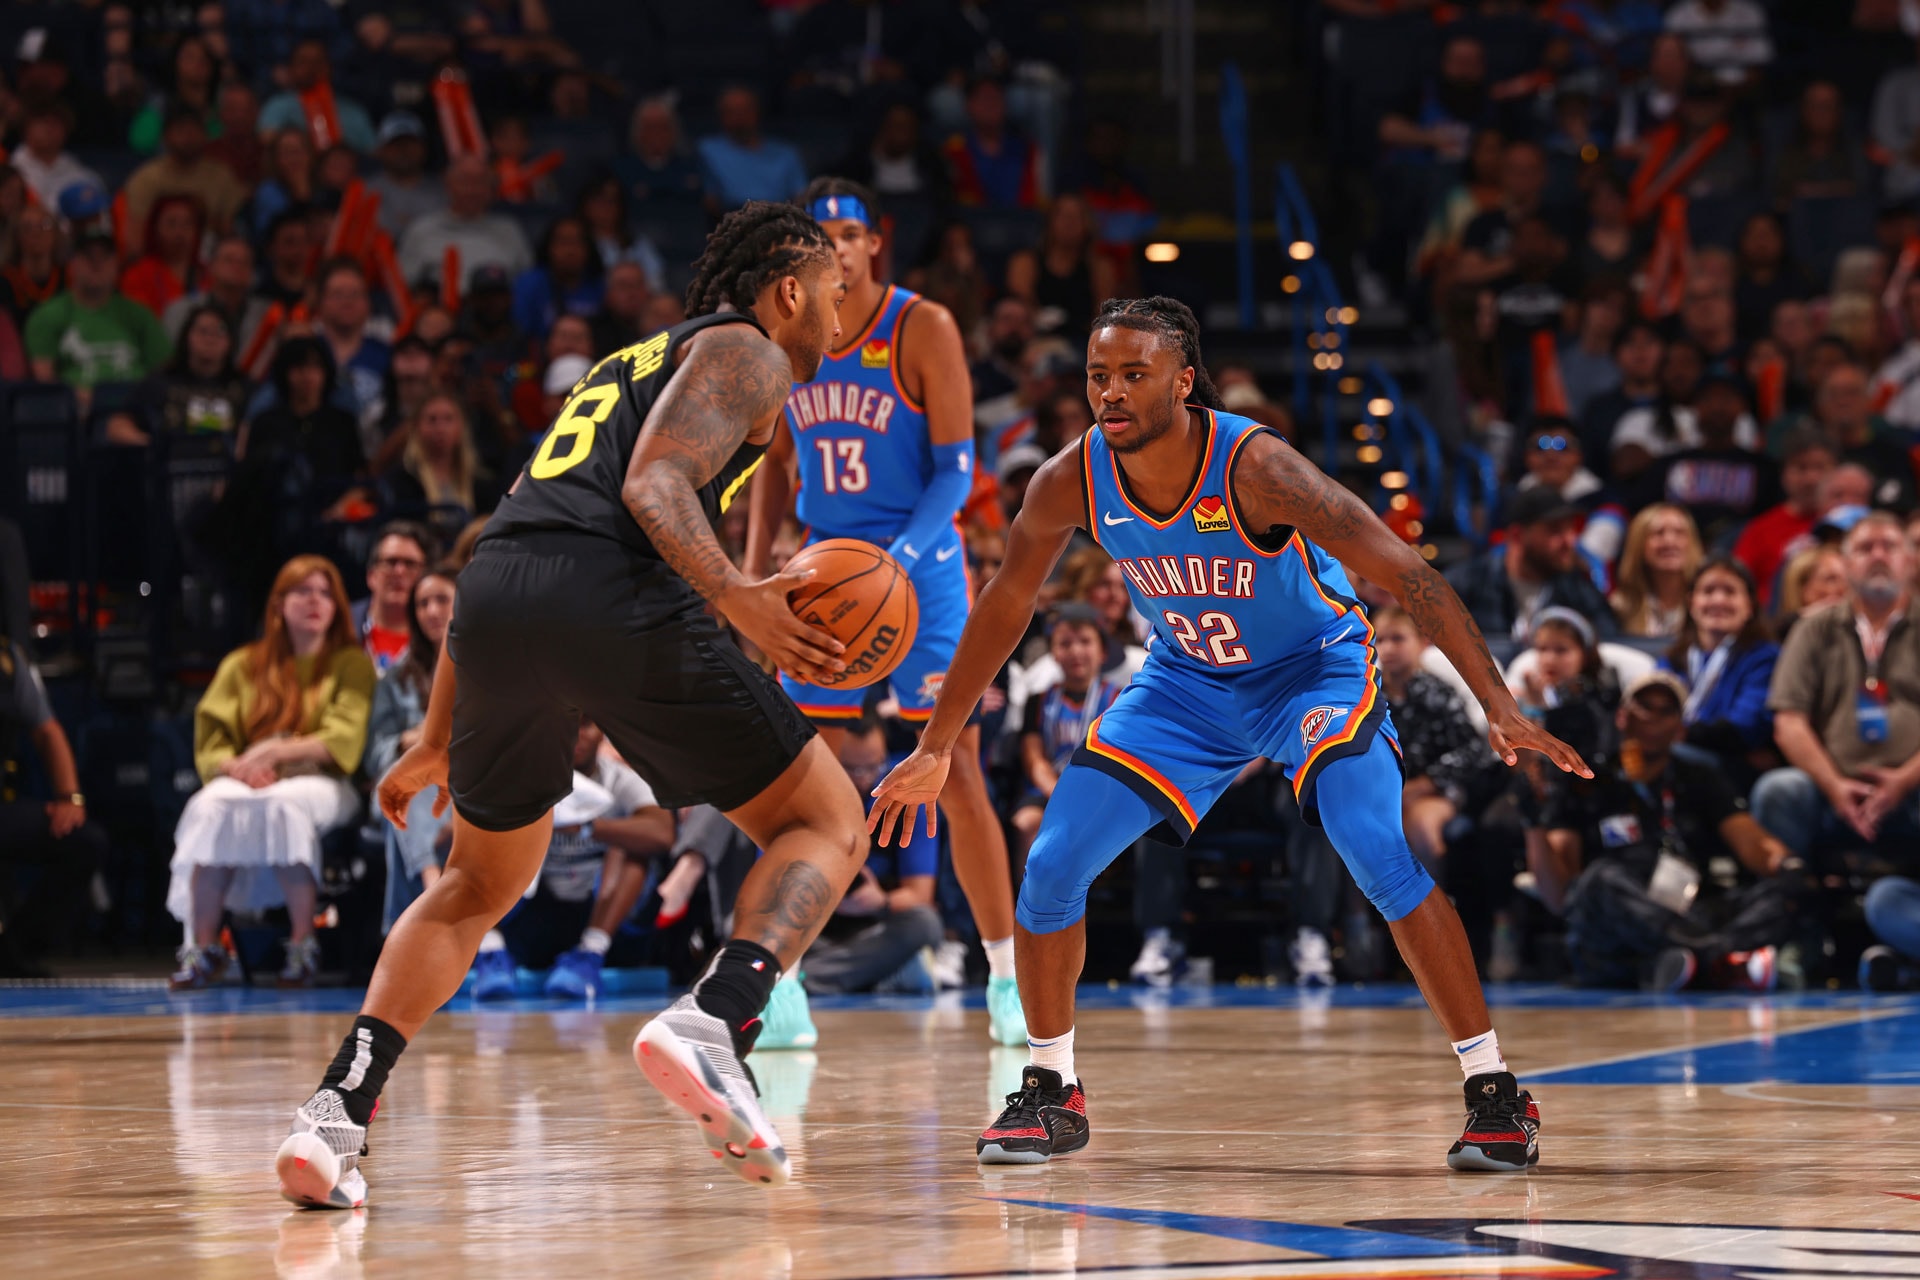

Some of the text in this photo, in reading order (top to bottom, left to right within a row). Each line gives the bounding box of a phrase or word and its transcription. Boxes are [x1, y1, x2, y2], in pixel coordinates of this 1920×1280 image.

[786, 381, 896, 434] THUNDER
[814, 437, 870, 494] 13
[1115, 554, 1256, 598] HUNDER
[1163, 610, 1252, 667] 22
